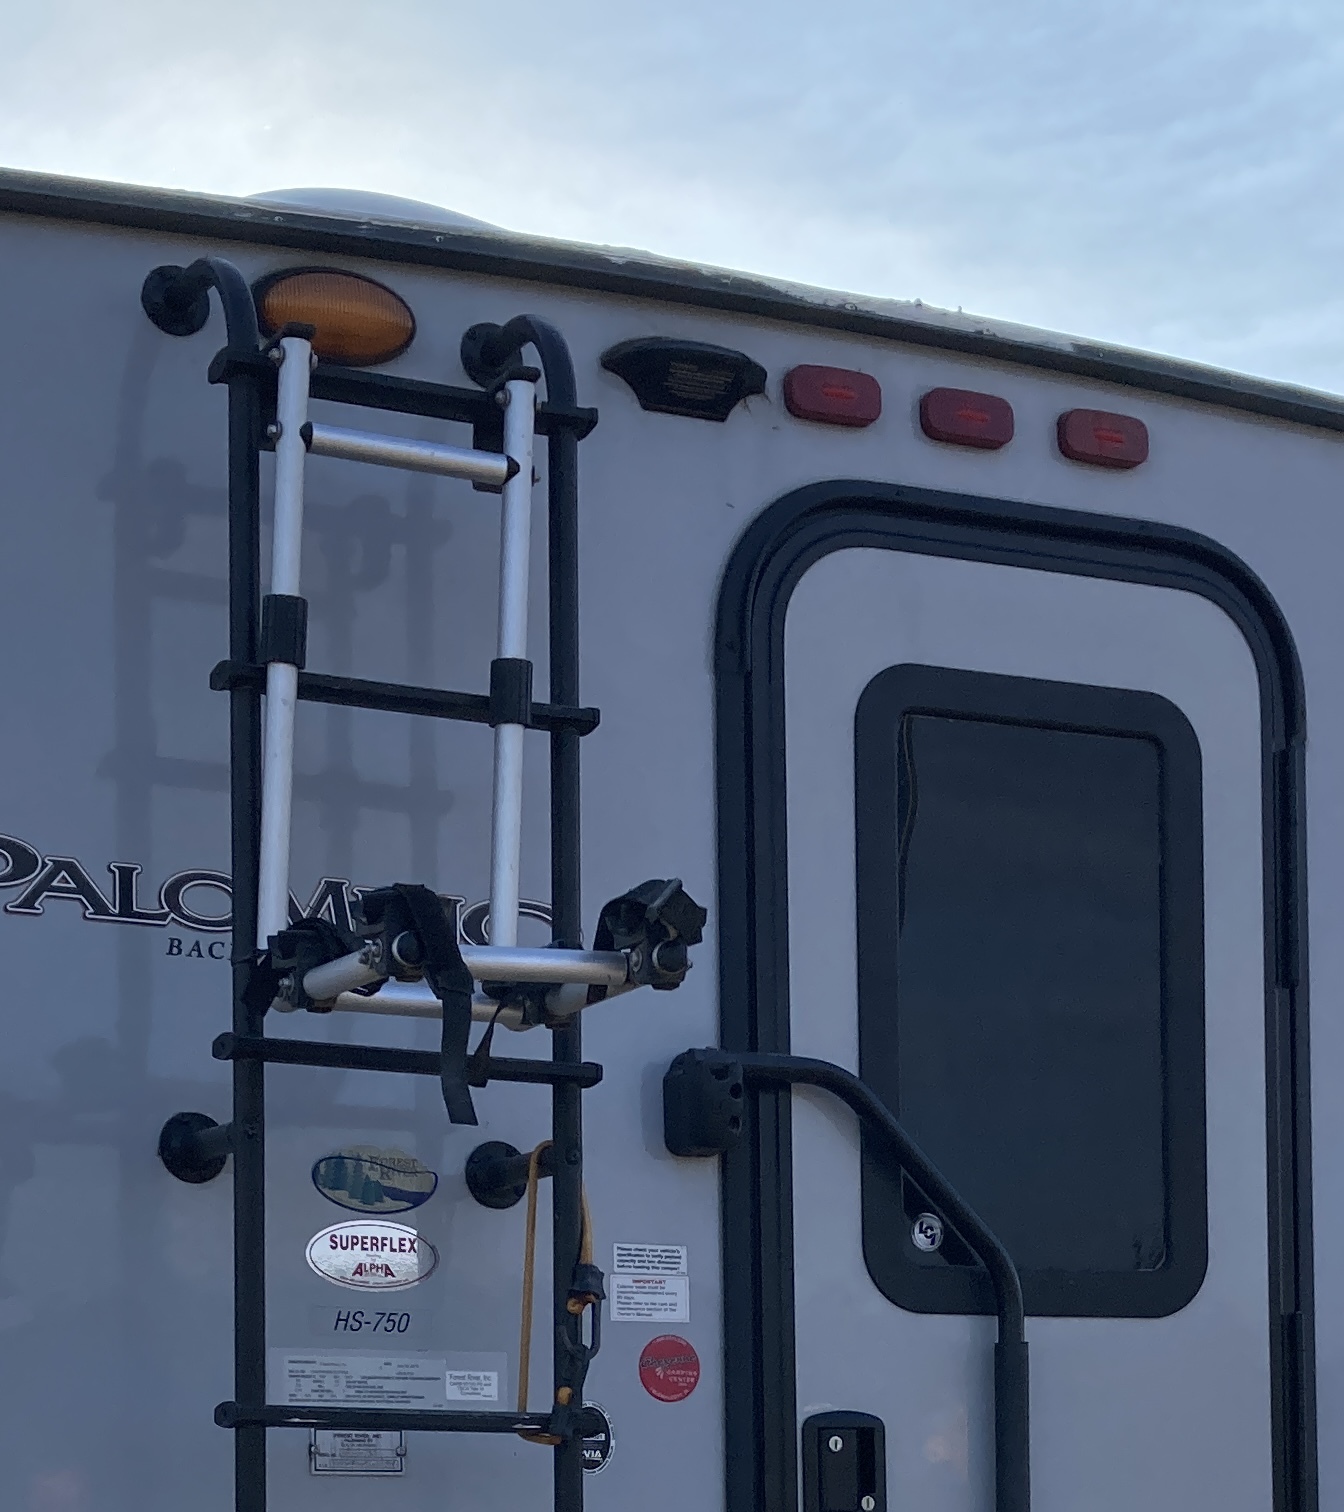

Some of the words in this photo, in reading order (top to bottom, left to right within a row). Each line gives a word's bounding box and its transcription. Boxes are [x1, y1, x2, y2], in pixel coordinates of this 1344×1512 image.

[329, 1233, 418, 1254] SUPERFLEX
[351, 1262, 396, 1278] ALPHA
[333, 1309, 411, 1333] HS-750
